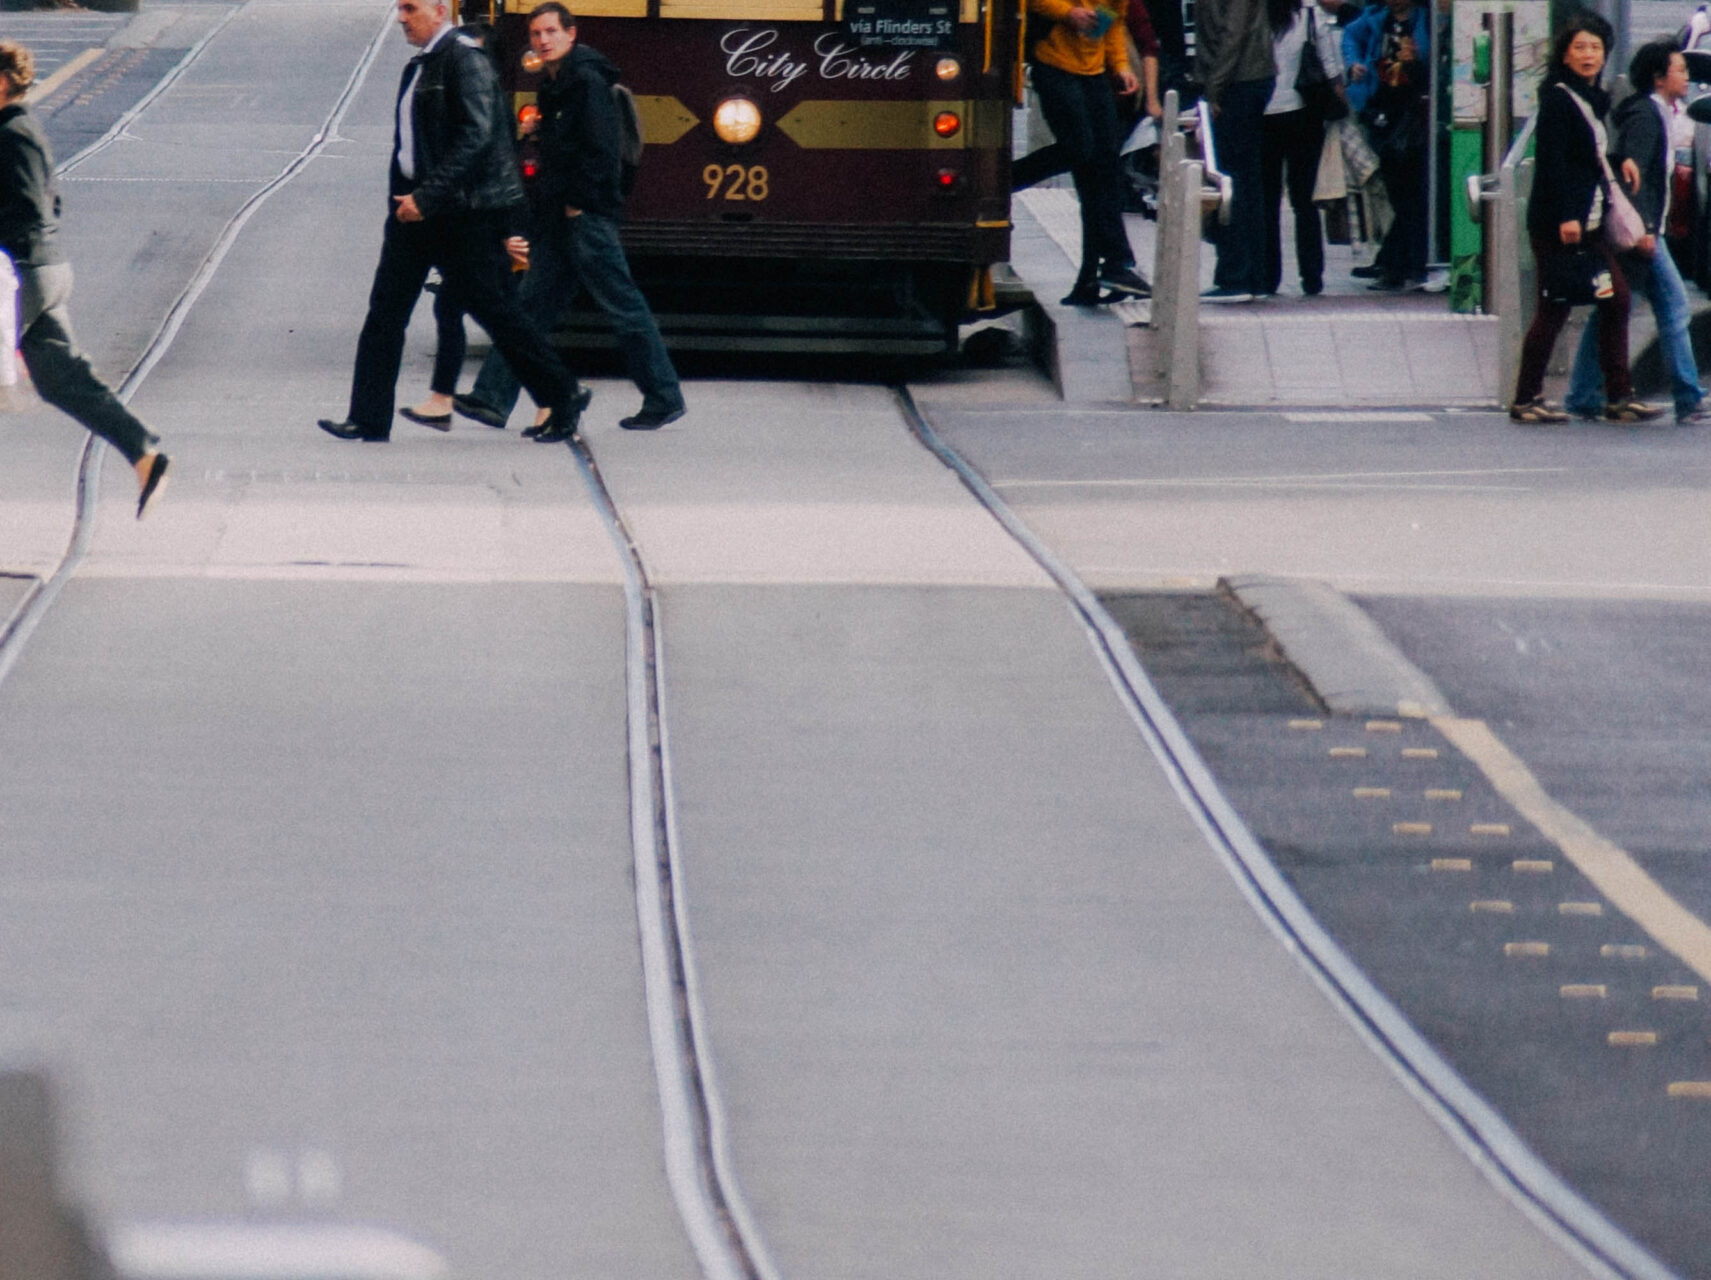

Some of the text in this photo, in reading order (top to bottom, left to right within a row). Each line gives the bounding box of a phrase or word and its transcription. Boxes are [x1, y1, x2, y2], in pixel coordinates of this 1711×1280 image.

[850, 19, 952, 34] via Flinders St
[720, 29, 916, 92] City Circle
[703, 163, 769, 201] 928
